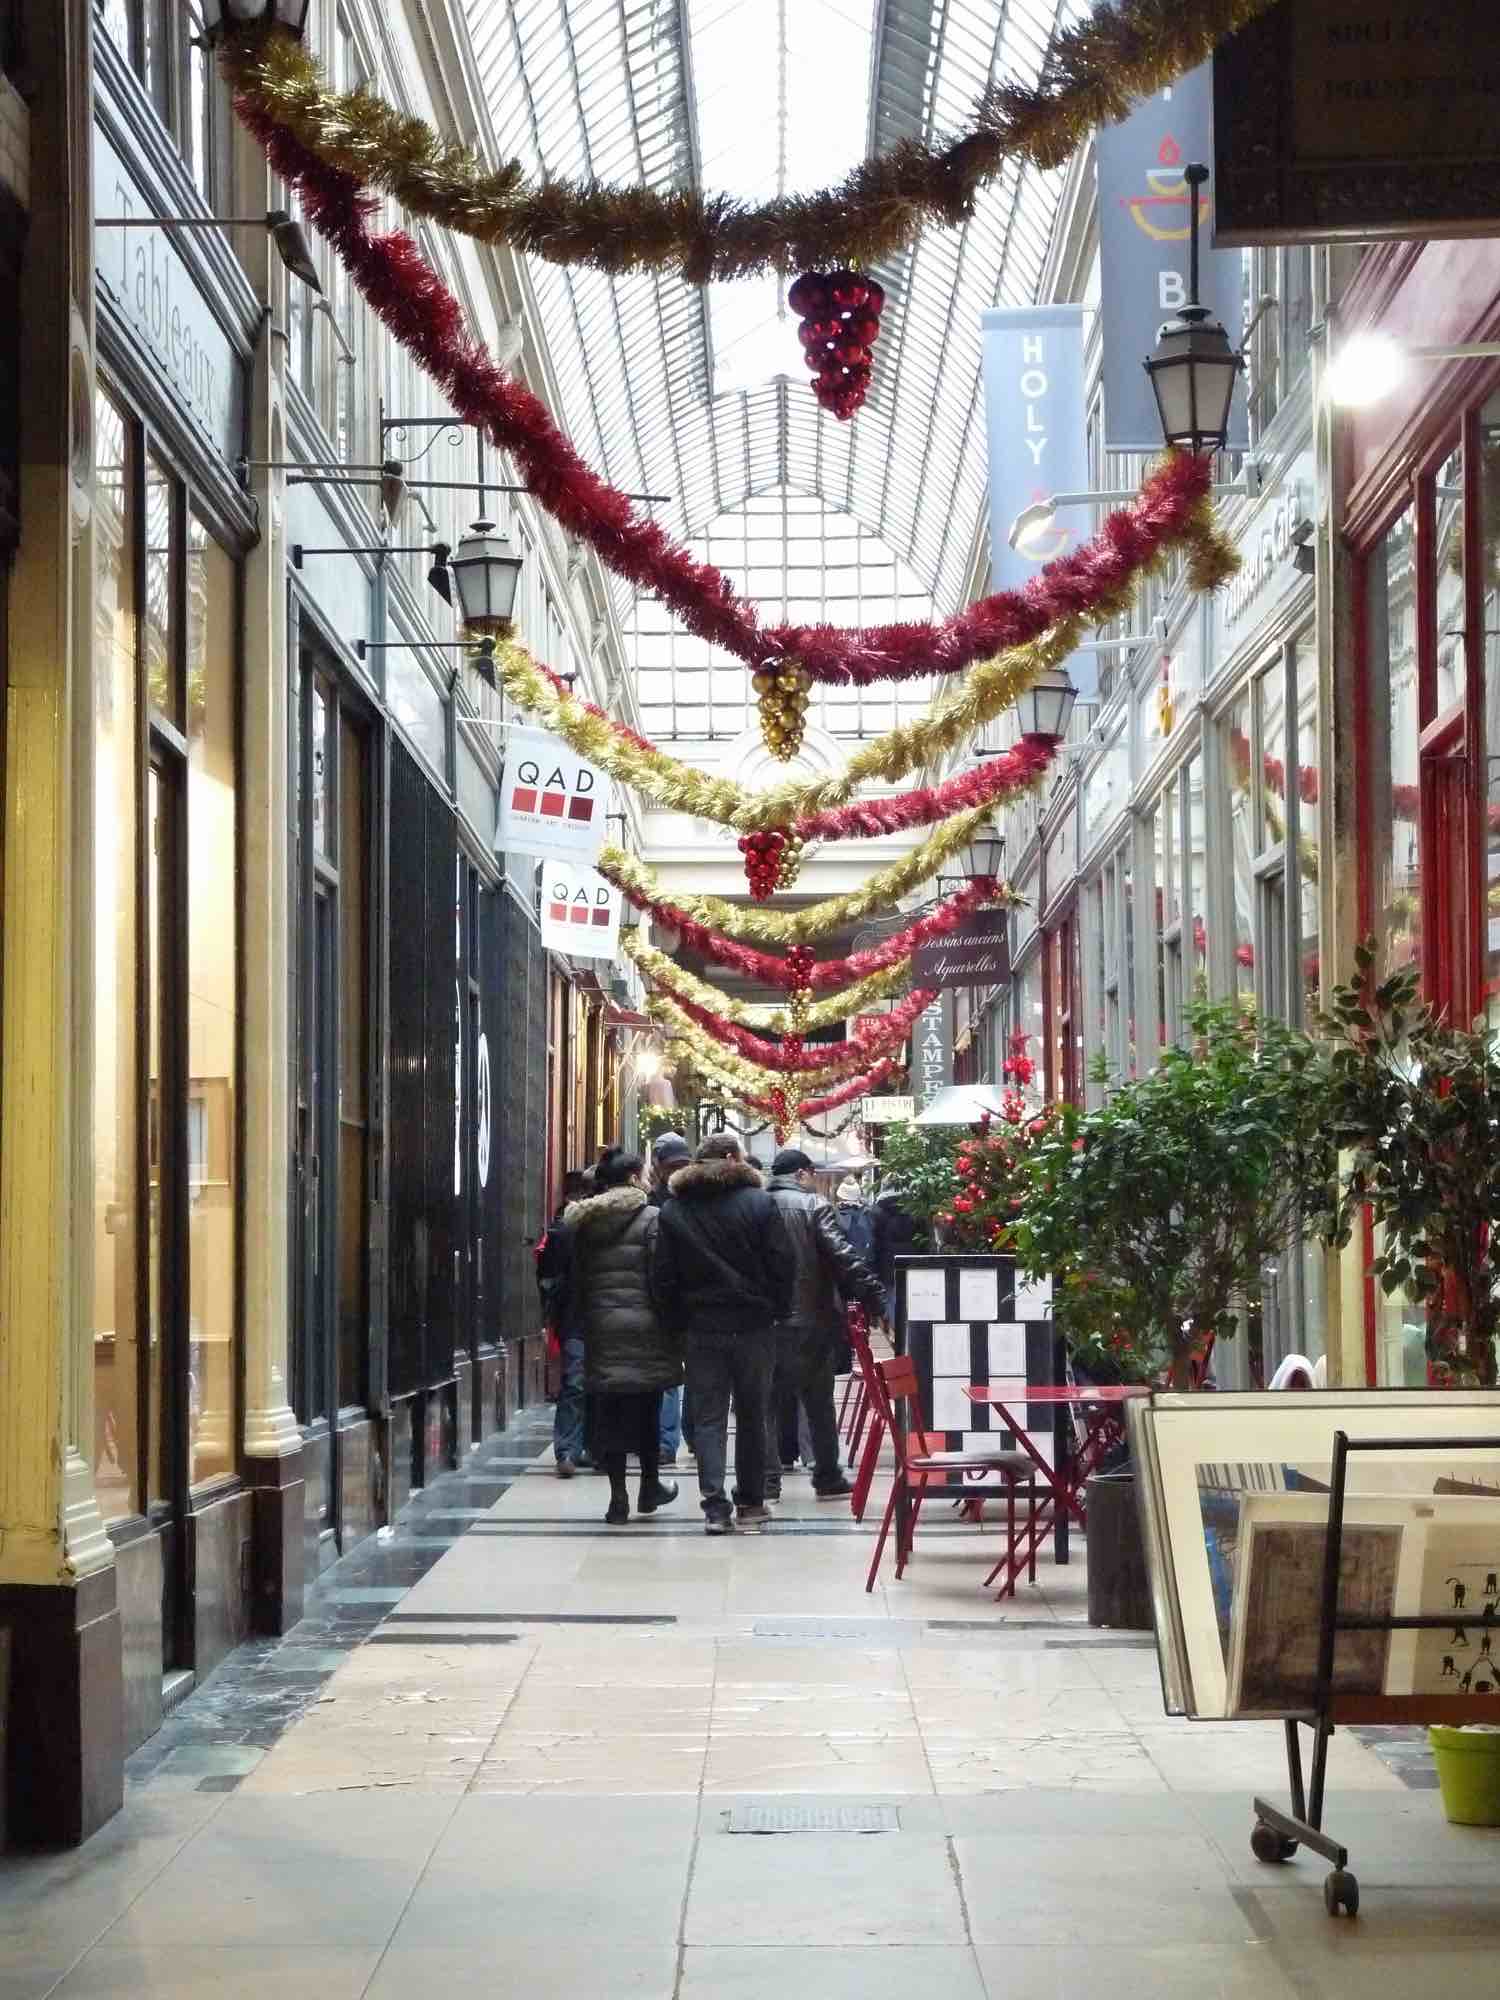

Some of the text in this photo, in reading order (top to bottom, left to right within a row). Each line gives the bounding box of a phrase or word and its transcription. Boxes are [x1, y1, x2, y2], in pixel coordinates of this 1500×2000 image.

[114, 180, 215, 425] Tableaux
[1021, 335, 1048, 465] HOLY
[517, 761, 594, 793] QAD
[552, 883, 610, 905] QAD
